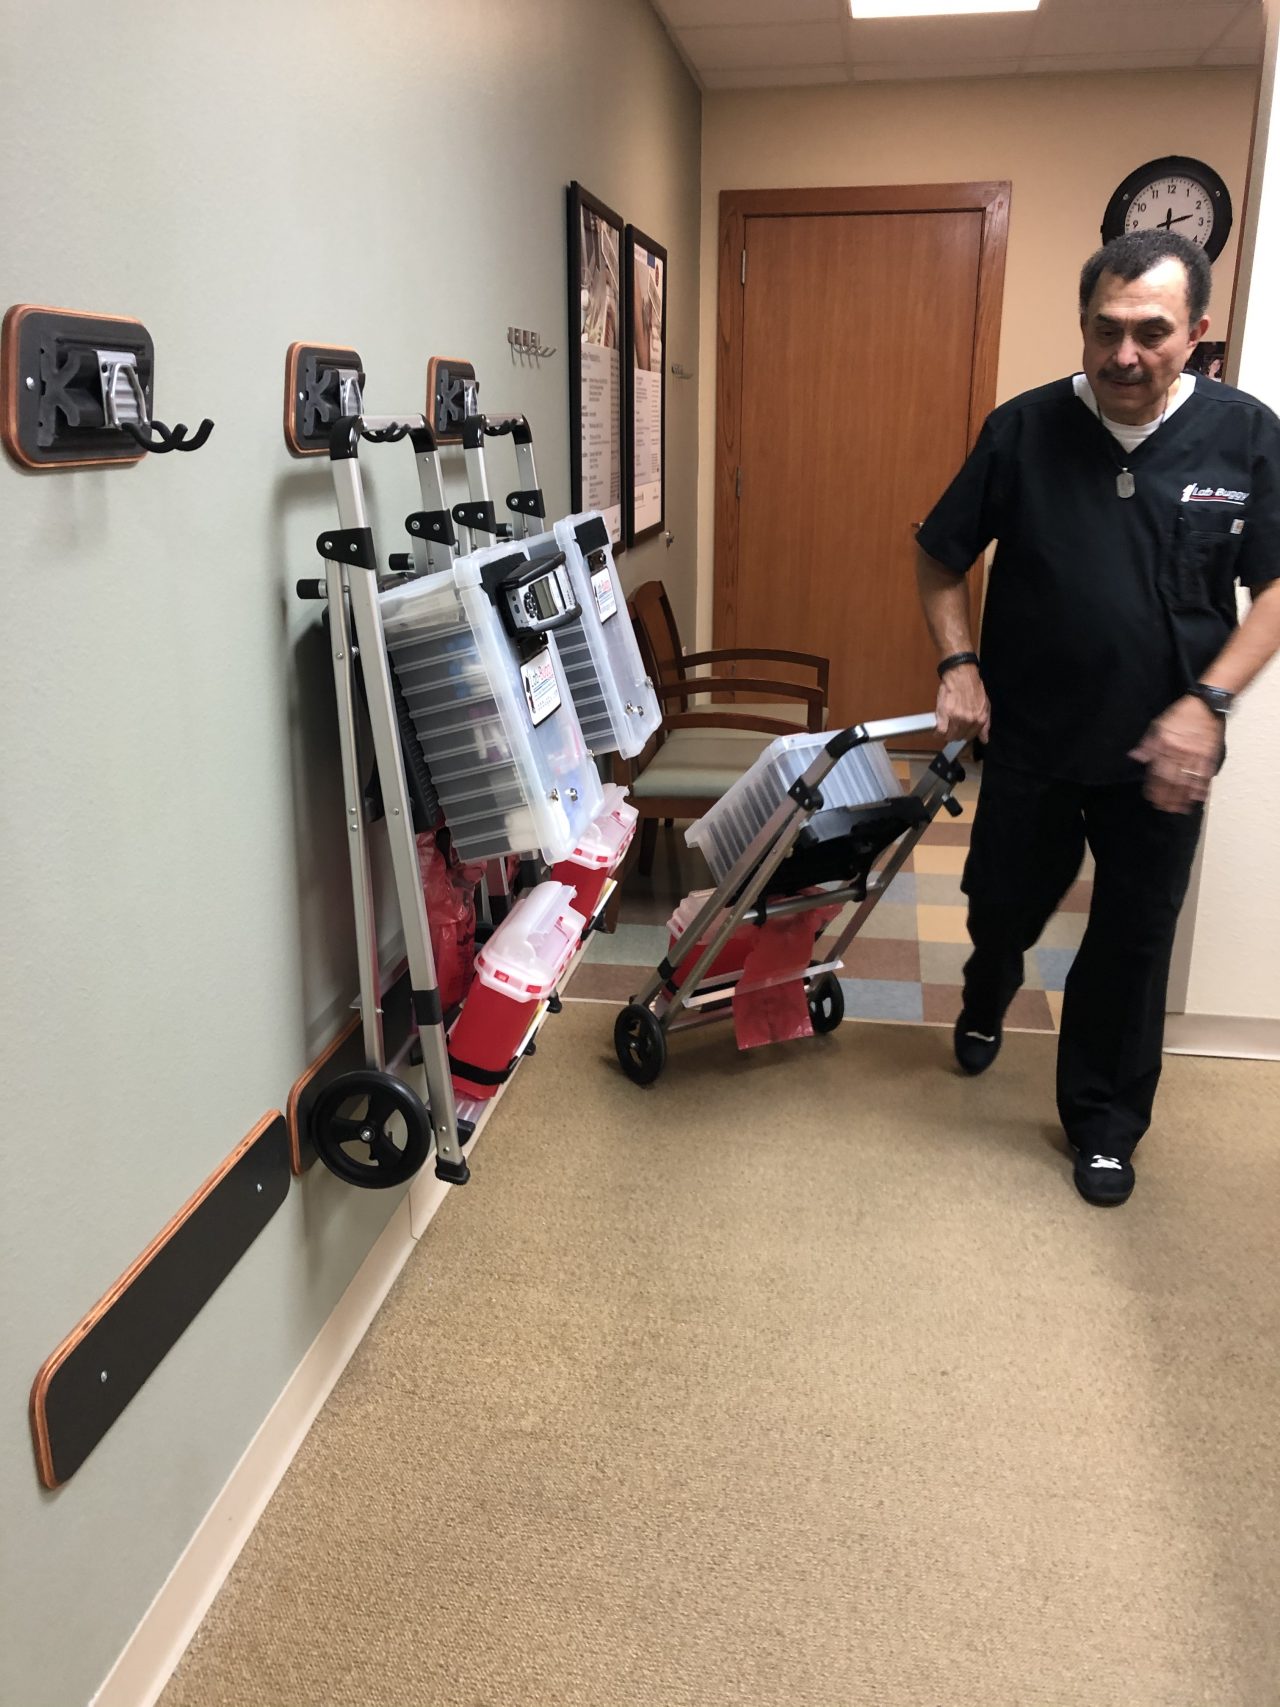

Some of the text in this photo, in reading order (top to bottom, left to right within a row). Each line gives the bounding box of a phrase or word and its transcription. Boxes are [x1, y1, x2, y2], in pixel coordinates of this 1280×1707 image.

[1167, 185, 1176, 194] 12
[1186, 188, 1190, 197] 1
[1152, 190, 1158, 199] 11
[1137, 203, 1146, 212] 10
[1196, 201, 1202, 210] 2
[1132, 220, 1138, 229] 9
[1198, 217, 1204, 226] 3
[1192, 235, 1198, 243] 4
